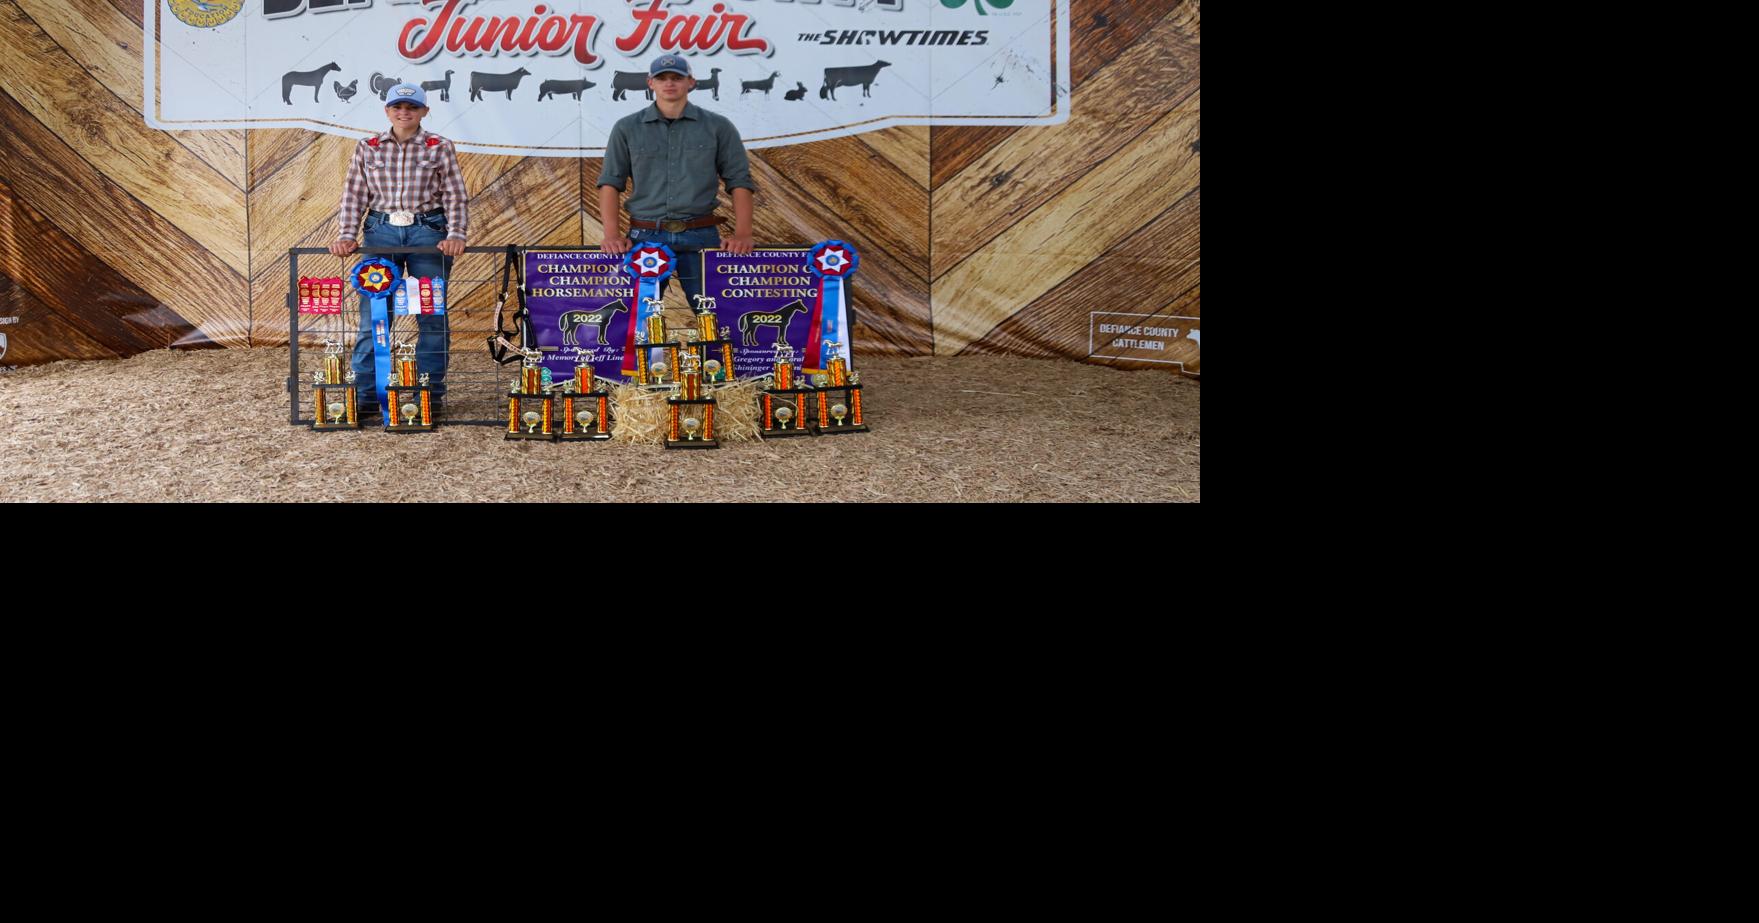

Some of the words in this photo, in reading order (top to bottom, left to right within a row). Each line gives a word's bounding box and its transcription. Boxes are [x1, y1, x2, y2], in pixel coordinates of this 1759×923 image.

[397, 0, 600, 67] Junior
[613, 0, 770, 54] Fair
[798, 33, 822, 41] THE
[819, 30, 990, 45] SHOWTIMES
[537, 264, 620, 274] CHAMPION
[717, 264, 798, 274] CHAMPION
[549, 276, 631, 286] CHAMPION
[728, 276, 811, 286] CHAMPION
[721, 288, 818, 298] CONTESTING
[573, 315, 602, 323] 2022
[752, 315, 782, 323] 2022
[1100, 324, 1141, 335] DEFIANCE
[1144, 327, 1178, 337] COUNTY
[1113, 339, 1164, 350] CATTLEMEN
